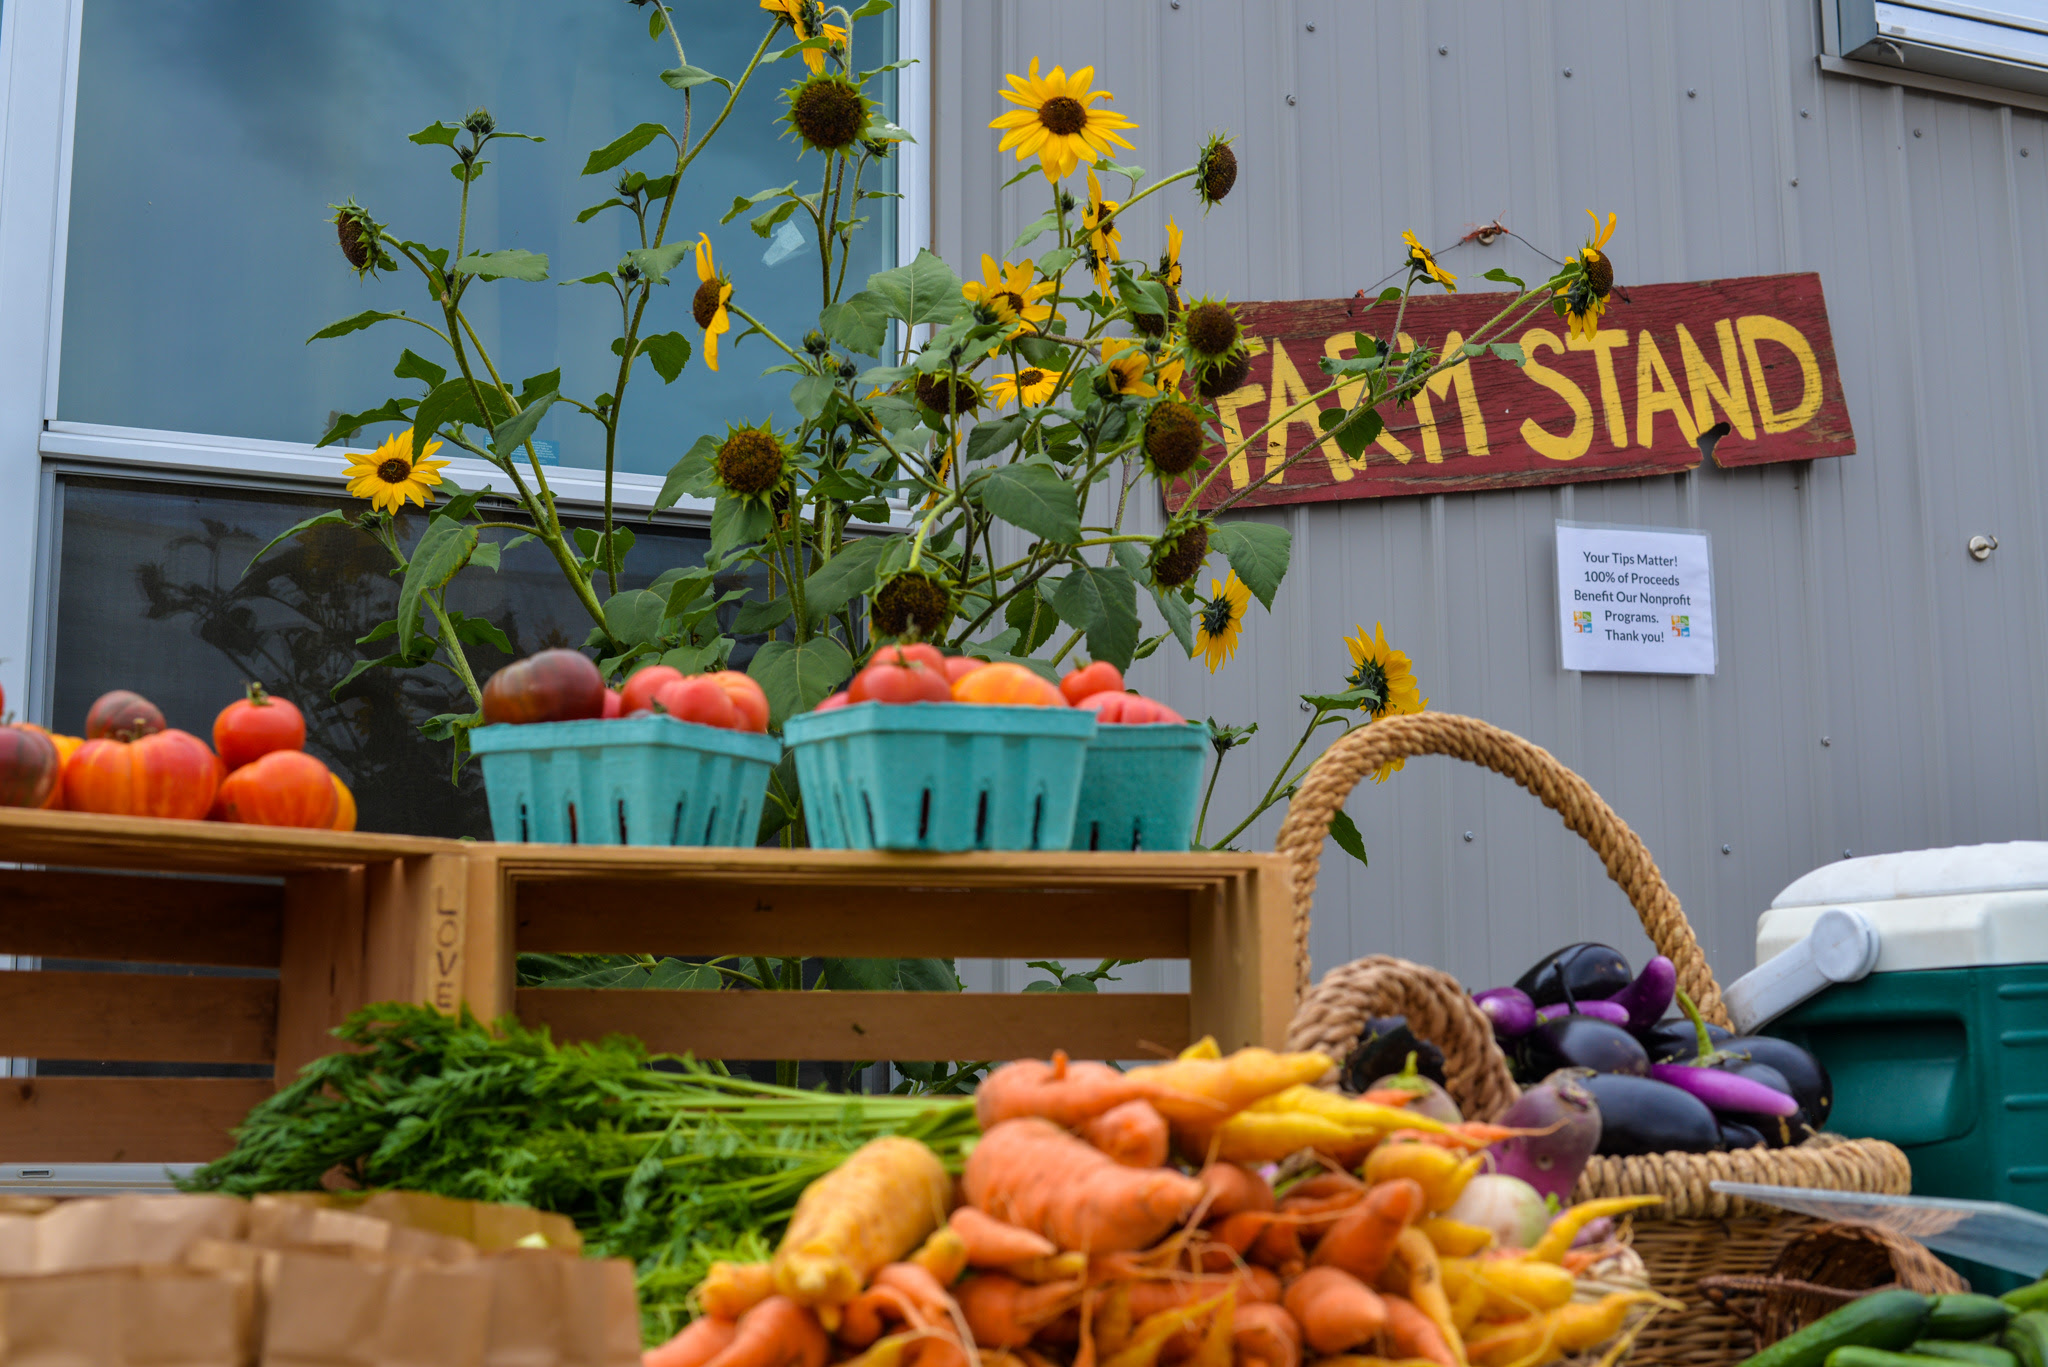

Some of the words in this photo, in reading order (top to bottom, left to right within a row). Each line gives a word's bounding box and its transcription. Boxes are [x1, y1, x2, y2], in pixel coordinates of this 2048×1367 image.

[1519, 314, 1823, 461] STAND
[1583, 552, 1609, 563] Your
[1612, 553, 1634, 566] Tips
[1637, 554, 1678, 567] Matter!
[1585, 571, 1615, 583] 100%
[1618, 573, 1629, 583] of
[1631, 573, 1680, 586] Proceeds
[1574, 590, 1613, 602] Benefit
[1616, 591, 1637, 603] Our
[1640, 593, 1691, 606] Nonprofit
[1605, 610, 1659, 624] Programs.
[1605, 630, 1639, 642] Thank
[1641, 632, 1664, 644] you!
[436, 886, 459, 1009] LOVE
